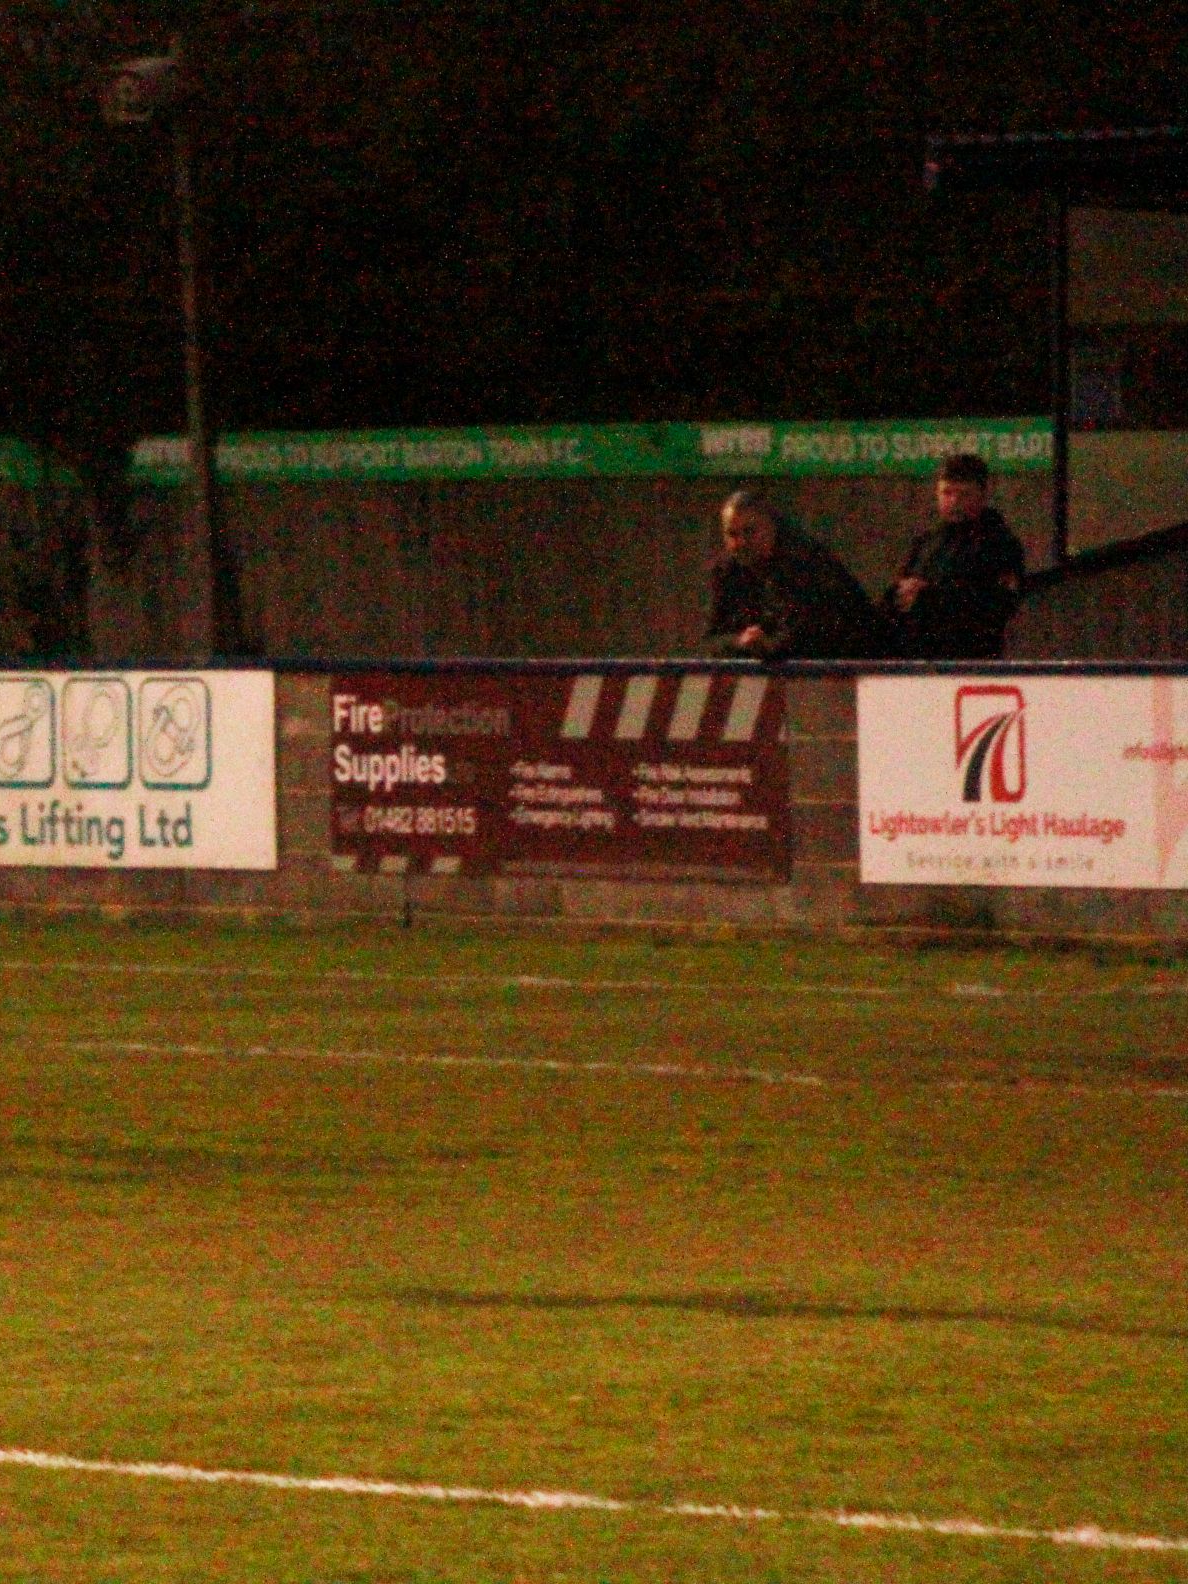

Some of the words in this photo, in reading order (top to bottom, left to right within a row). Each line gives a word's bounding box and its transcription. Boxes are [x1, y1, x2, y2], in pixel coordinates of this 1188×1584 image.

[782, 433, 855, 463] PROUD
[858, 433, 888, 462] TO
[333, 694, 383, 733] Fire
[333, 744, 447, 790] Supplies
[21, 800, 125, 860] Lifting
[140, 803, 193, 848] Ltd
[990, 812, 1039, 843] Light
[1043, 812, 1127, 844] Haulage
